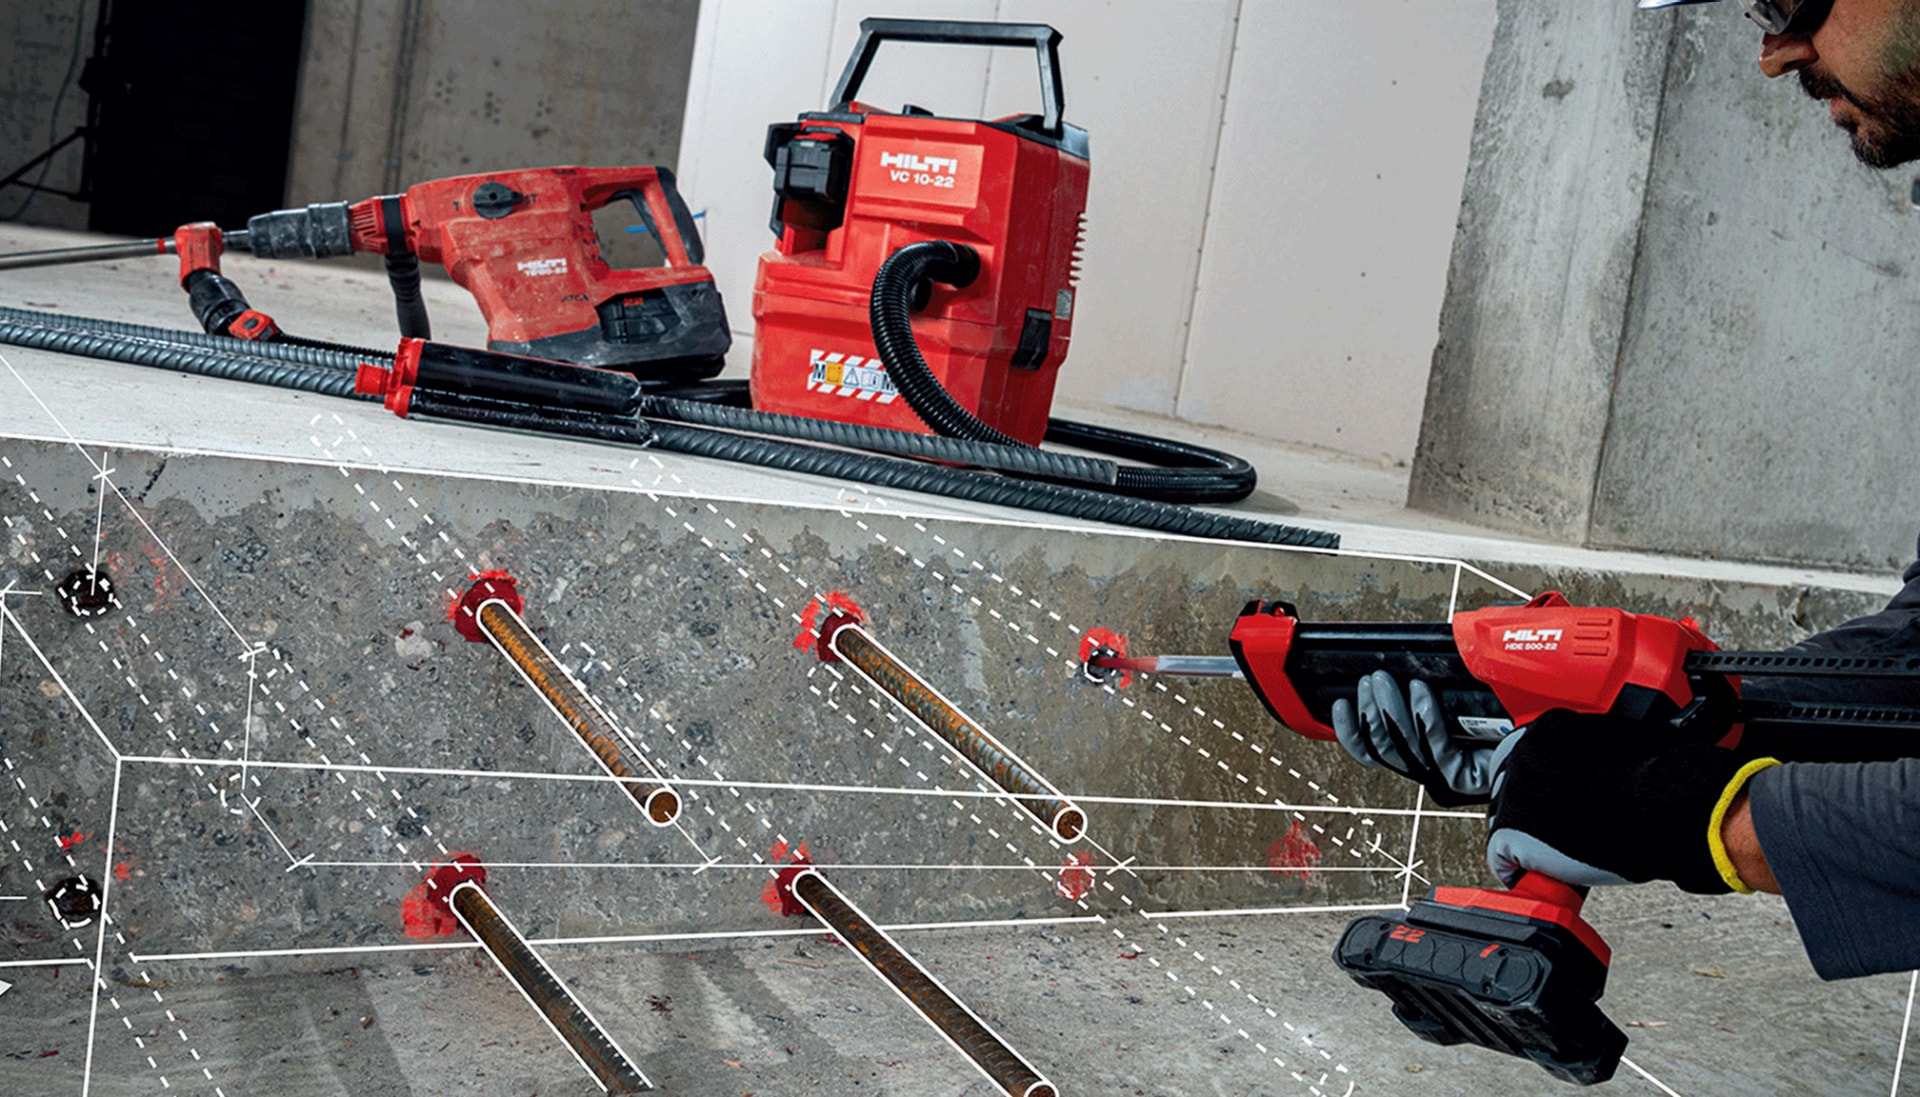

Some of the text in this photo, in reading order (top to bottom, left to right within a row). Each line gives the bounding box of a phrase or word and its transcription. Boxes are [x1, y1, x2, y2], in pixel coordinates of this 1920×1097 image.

[880, 151, 958, 175] HILTI
[890, 169, 955, 188] VC 10-22
[517, 258, 567, 271] HILTI
[1502, 629, 1563, 642] HILTI
[1389, 925, 1426, 944] 22
